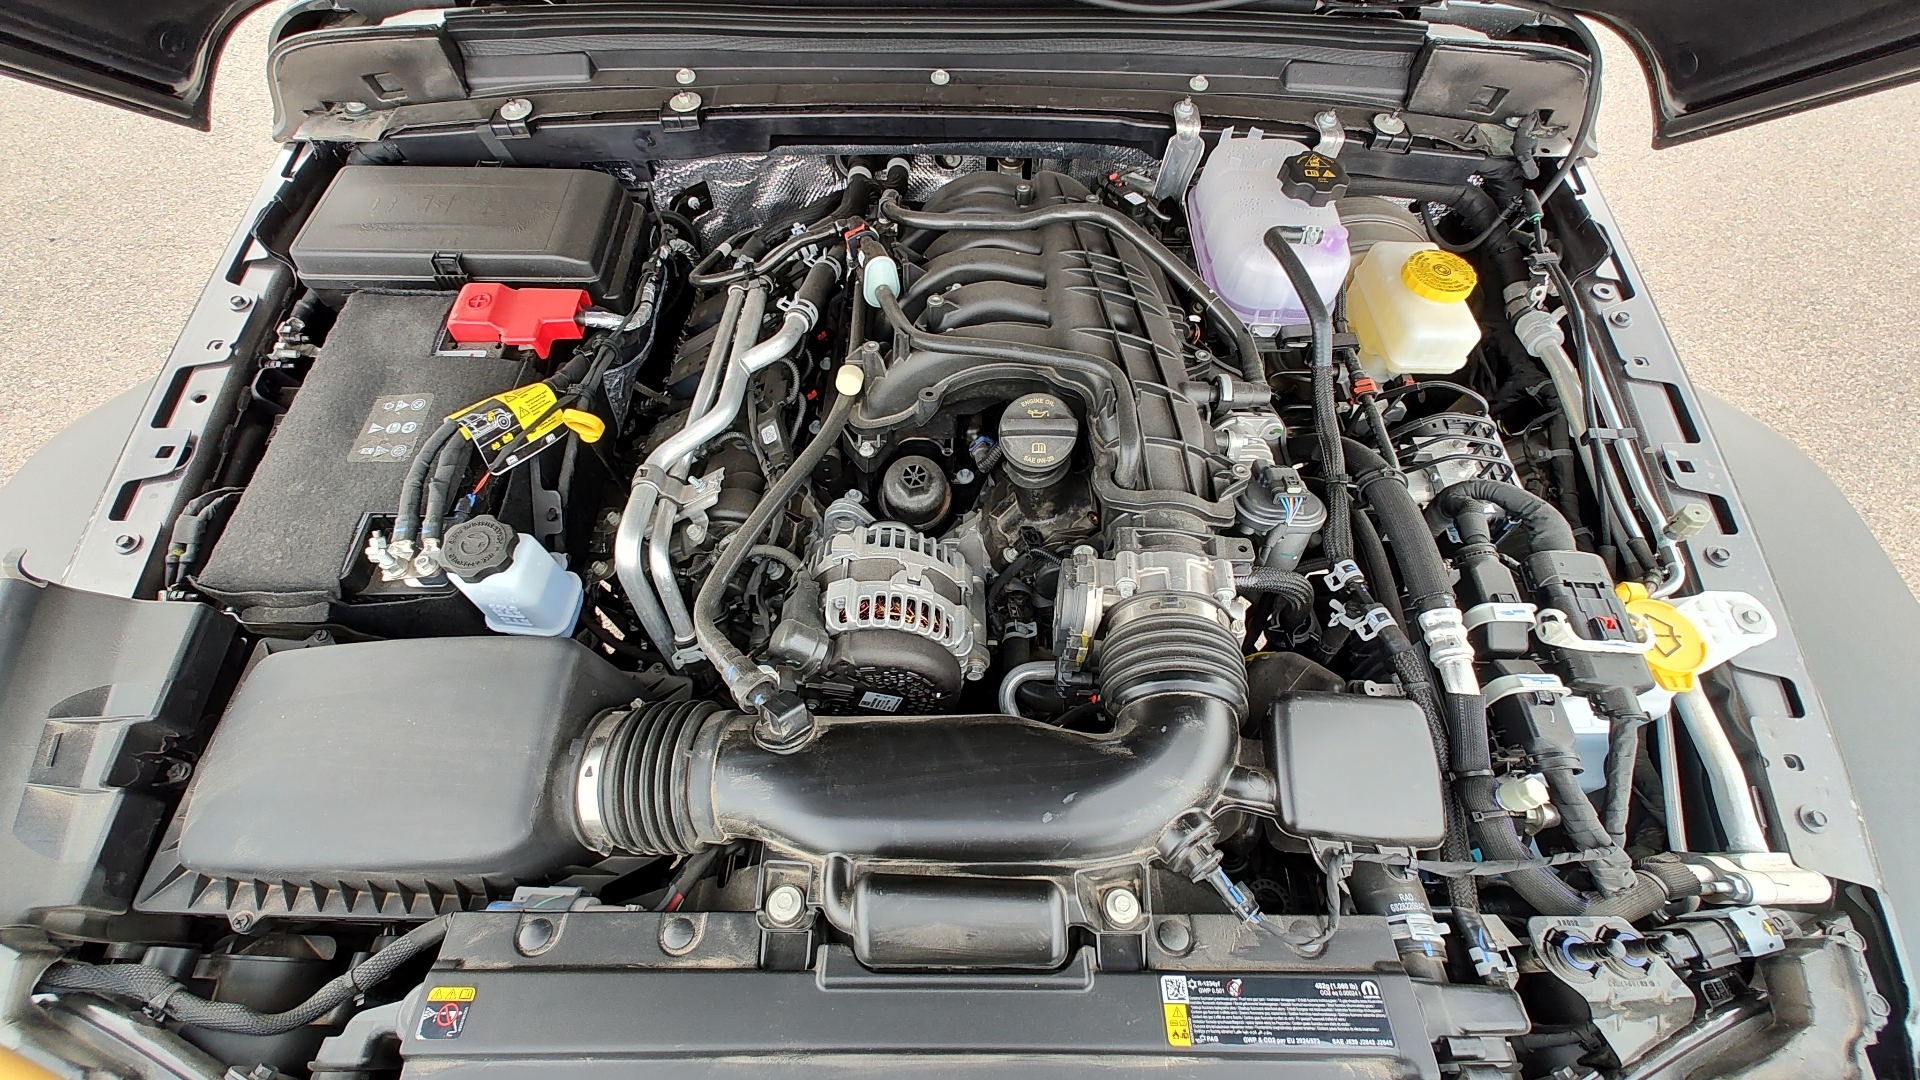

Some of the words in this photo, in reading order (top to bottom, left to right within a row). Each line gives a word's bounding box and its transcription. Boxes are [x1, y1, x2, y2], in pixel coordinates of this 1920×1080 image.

[1021, 398, 1044, 407] ENGINE
[1045, 399, 1055, 407] OIL
[1023, 455, 1036, 463] SAE
[1036, 455, 1055, 464] 0W-20
[1398, 893, 1414, 901] RAD
